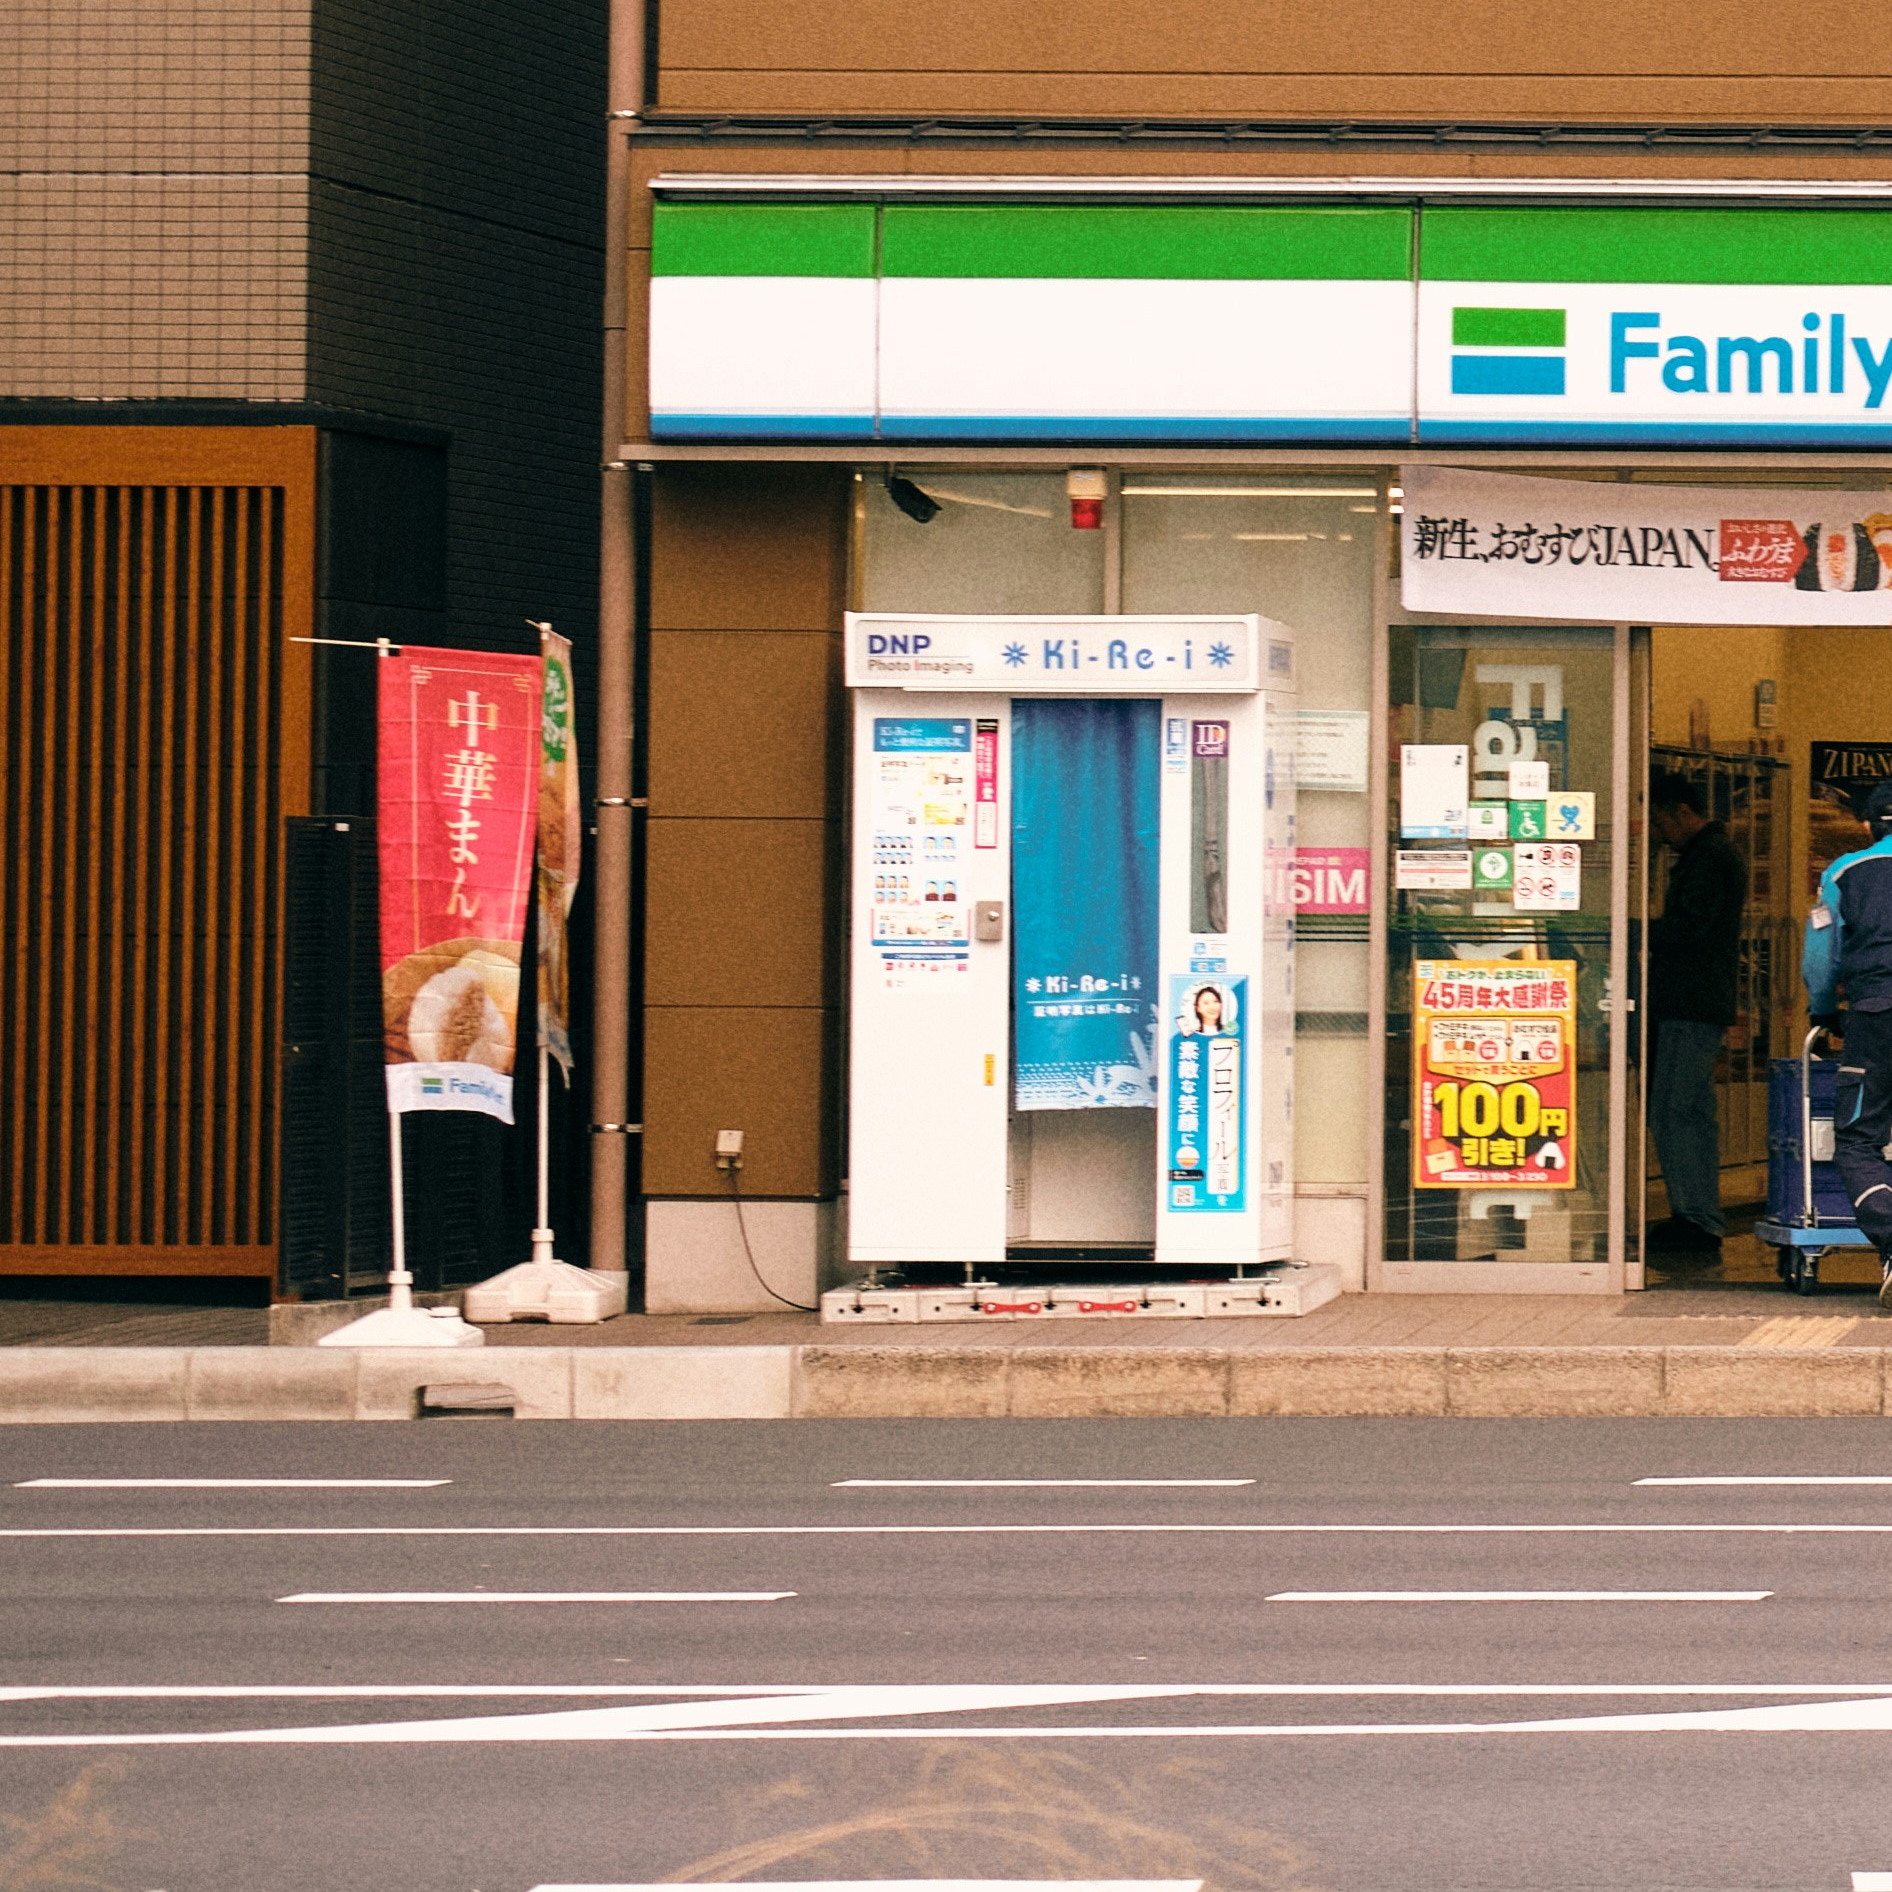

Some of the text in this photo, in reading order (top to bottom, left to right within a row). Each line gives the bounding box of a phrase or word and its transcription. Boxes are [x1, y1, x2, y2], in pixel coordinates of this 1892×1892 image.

[868, 635, 931, 655] DNP
[1043, 640, 1194, 669] Ki-Re-i
[868, 659, 974, 674] Photo Imaging
[442, 691, 498, 919] 中華まん
[1045, 973, 1129, 994] Ki-Re-i
[1422, 981, 1569, 1009] 45周年大感謝祭
[1433, 1081, 1568, 1138] 100円
